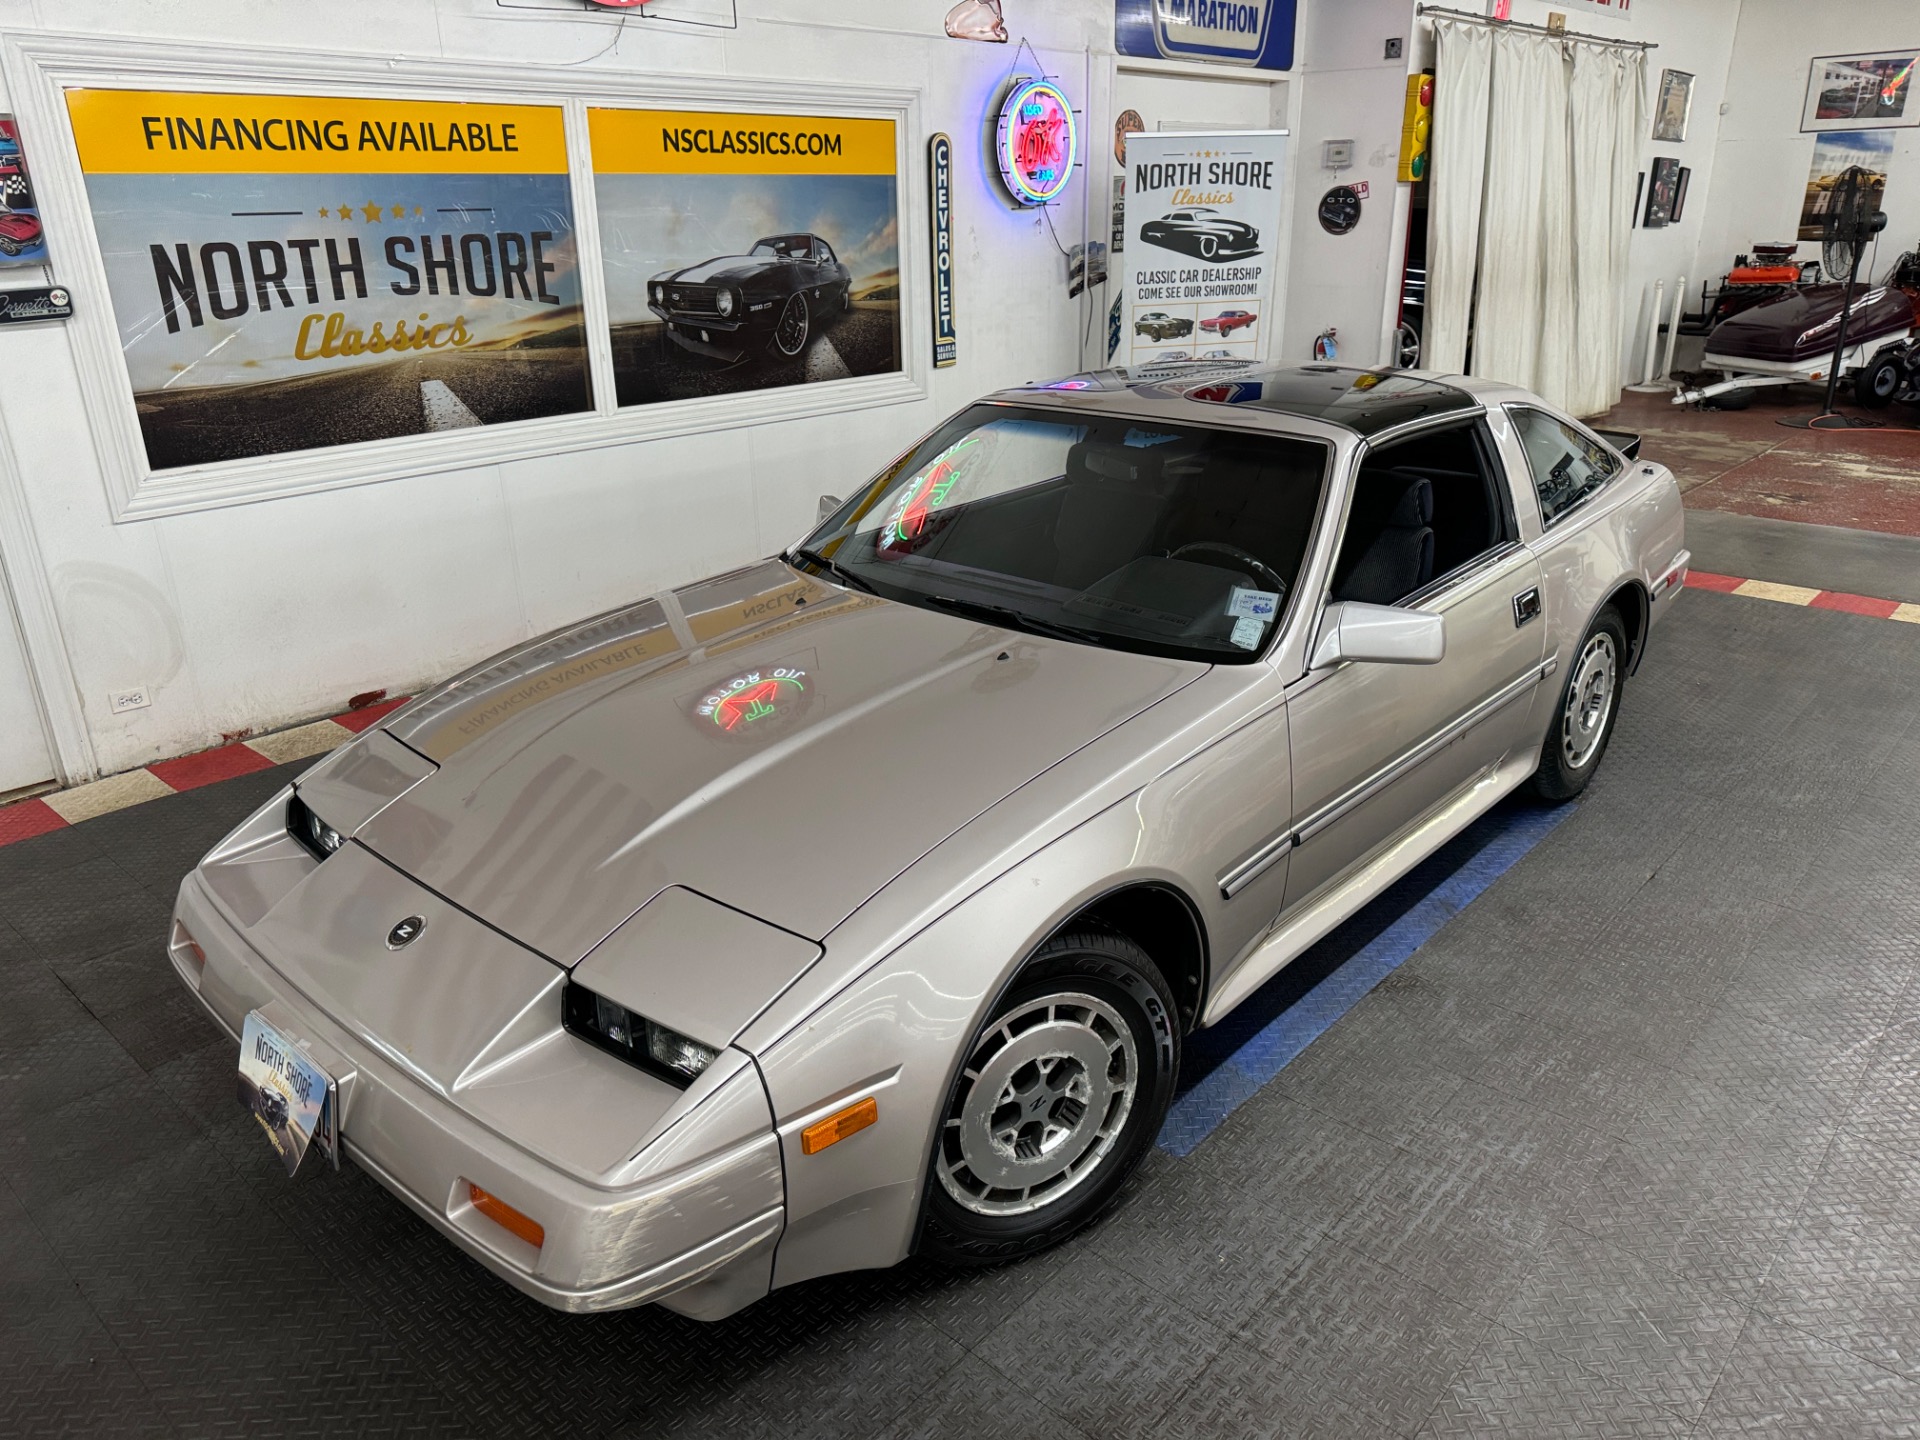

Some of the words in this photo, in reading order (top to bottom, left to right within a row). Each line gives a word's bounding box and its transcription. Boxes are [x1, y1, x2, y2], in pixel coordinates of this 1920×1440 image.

[1171, 0, 1259, 34] MARATHON
[142, 116, 349, 152] FINANCING
[358, 121, 519, 153] AVAILABLE
[662, 127, 842, 156] NSCLASSICS.COM
[1135, 162, 1201, 193] NORTH
[1208, 161, 1274, 190] SHORE
[1171, 188, 1235, 205] Classics
[936, 145, 950, 333] CHEVROLET
[149, 236, 369, 334] NORTH
[384, 231, 561, 305] SHORE
[1136, 270, 1177, 285] CLASSIC
[1179, 269, 1199, 284] CAR
[1202, 267, 1262, 282] DEALERSHIP
[1138, 287, 1163, 300] COME
[1165, 286, 1182, 299] SEE
[1184, 285, 1201, 298] OUR
[1204, 283, 1258, 297] SHOWROOM!
[294, 312, 473, 361] Classics
[255, 1035, 285, 1073] NORTH
[285, 1061, 313, 1108] SHORE
